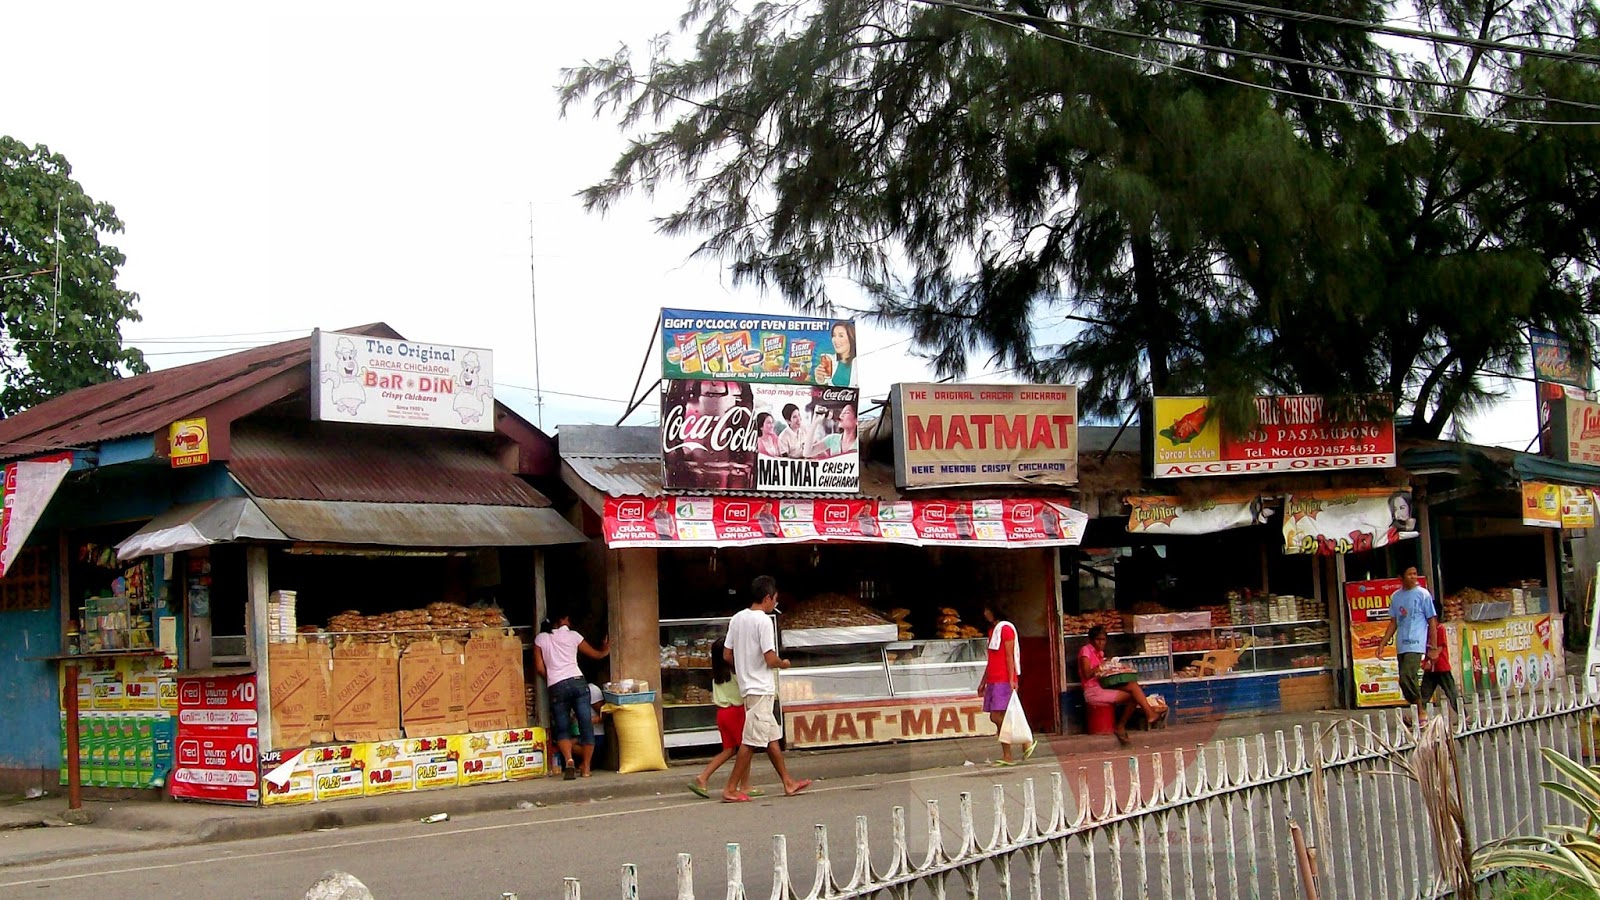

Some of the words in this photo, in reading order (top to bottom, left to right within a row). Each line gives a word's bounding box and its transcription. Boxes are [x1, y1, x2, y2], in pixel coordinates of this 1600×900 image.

[664, 319, 693, 330] EIGHT
[696, 319, 737, 330] O'CLOCK
[740, 320, 760, 331] GOT
[761, 321, 786, 332] EVEN
[366, 340, 393, 355] The
[398, 343, 456, 363] Original
[369, 359, 402, 370] CARCAR
[404, 362, 450, 374] CHICHARON
[760, 371, 789, 379] protection
[381, 391, 402, 401] Crispy
[404, 392, 437, 403] Chicharon
[756, 388, 776, 396] Sarap
[778, 390, 794, 398] mag
[909, 392, 927, 400] THE
[934, 392, 975, 400] ORIGINAL
[980, 392, 1014, 400] CARCAR
[1020, 392, 1067, 401] CHICHARON
[1284, 397, 1324, 425] CRISPY
[663, 405, 758, 453] Coca-Cola
[907, 415, 1074, 450] MATMAT
[1278, 426, 1379, 442] PASALUBONG
[1244, 448, 1266, 458] Tel.
[176, 456, 192, 466] LOAD
[193, 454, 203, 464] NA!
[1165, 461, 1279, 476] ACCEPT
[1290, 456, 1388, 469] ORDER
[822, 462, 855, 474] CRISPY
[911, 465, 935, 474] NENE
[941, 465, 977, 474] MENONG
[981, 465, 1011, 473] CRISPY
[1018, 463, 1066, 472] CHICHARON
[622, 507, 640, 516] red
[728, 507, 746, 517] red
[828, 510, 846, 518] red
[926, 509, 943, 517] red
[1015, 509, 1030, 517] red
[720, 532, 738, 540] LOW
[725, 526, 751, 534] CRAZY
[1351, 596, 1382, 610] LOAD
[406, 664, 437, 699] FORTUNE
[470, 660, 498, 693] FORTUNE
[272, 669, 302, 699] ORTUNE
[338, 668, 370, 701] FORTUNE
[184, 688, 198, 698] red
[206, 712, 214, 722] 10
[230, 712, 239, 722] 20
[474, 719, 500, 728] FORTUNE
[792, 706, 983, 743] MAT-MAT
[183, 748, 197, 757] red
[206, 758, 226, 766] COMBO
[506, 756, 525, 770] P0.25
[205, 772, 213, 782] 10
[228, 773, 238, 782] 20
[418, 765, 438, 780] P0.25
[318, 776, 341, 790] P0.25
